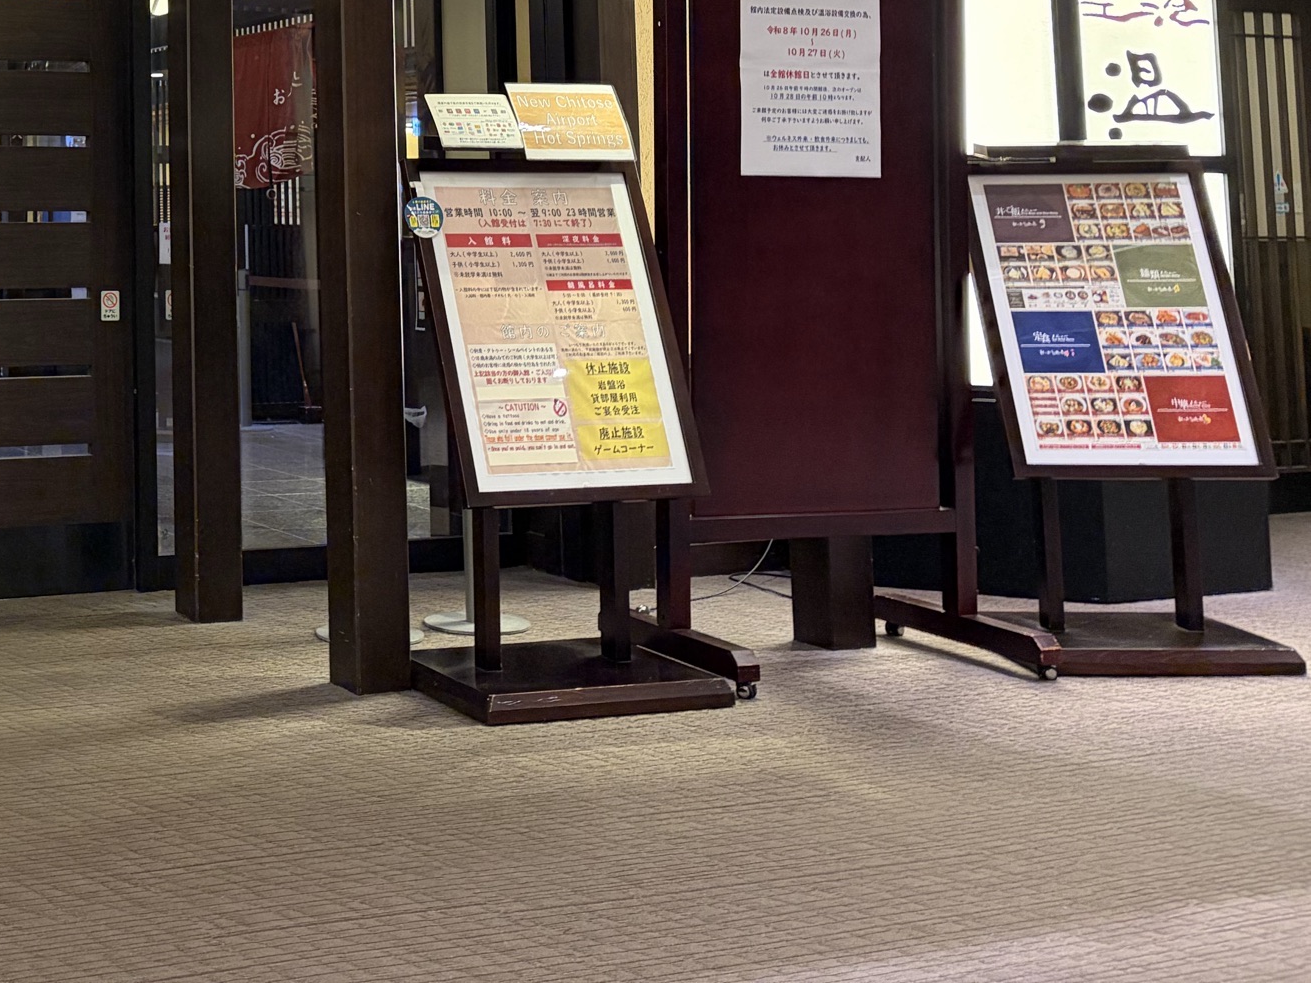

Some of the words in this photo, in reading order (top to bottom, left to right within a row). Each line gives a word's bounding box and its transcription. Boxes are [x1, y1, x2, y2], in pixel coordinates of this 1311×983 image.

[764, 69, 860, 81] は全館休館日とさせて頂きます。
[516, 95, 550, 108] New
[555, 95, 613, 109] Chitose
[546, 113, 598, 128] Airport
[534, 131, 562, 145] Hot
[566, 132, 624, 148] Springs
[444, 208, 483, 217] 営業時間
[489, 208, 512, 217] 10:00
[468, 236, 511, 245] 入館料
[562, 235, 600, 243] 深夜料金
[586, 362, 631, 375] 休止施設
[598, 380, 626, 390] 岩盤浴
[591, 392, 637, 404] 貸部屋利用
[504, 403, 540, 412] CATUTION
[594, 405, 640, 416] ご宴会受注
[599, 427, 644, 440] 廃止施設
[594, 444, 654, 455] ゲームコーナー
